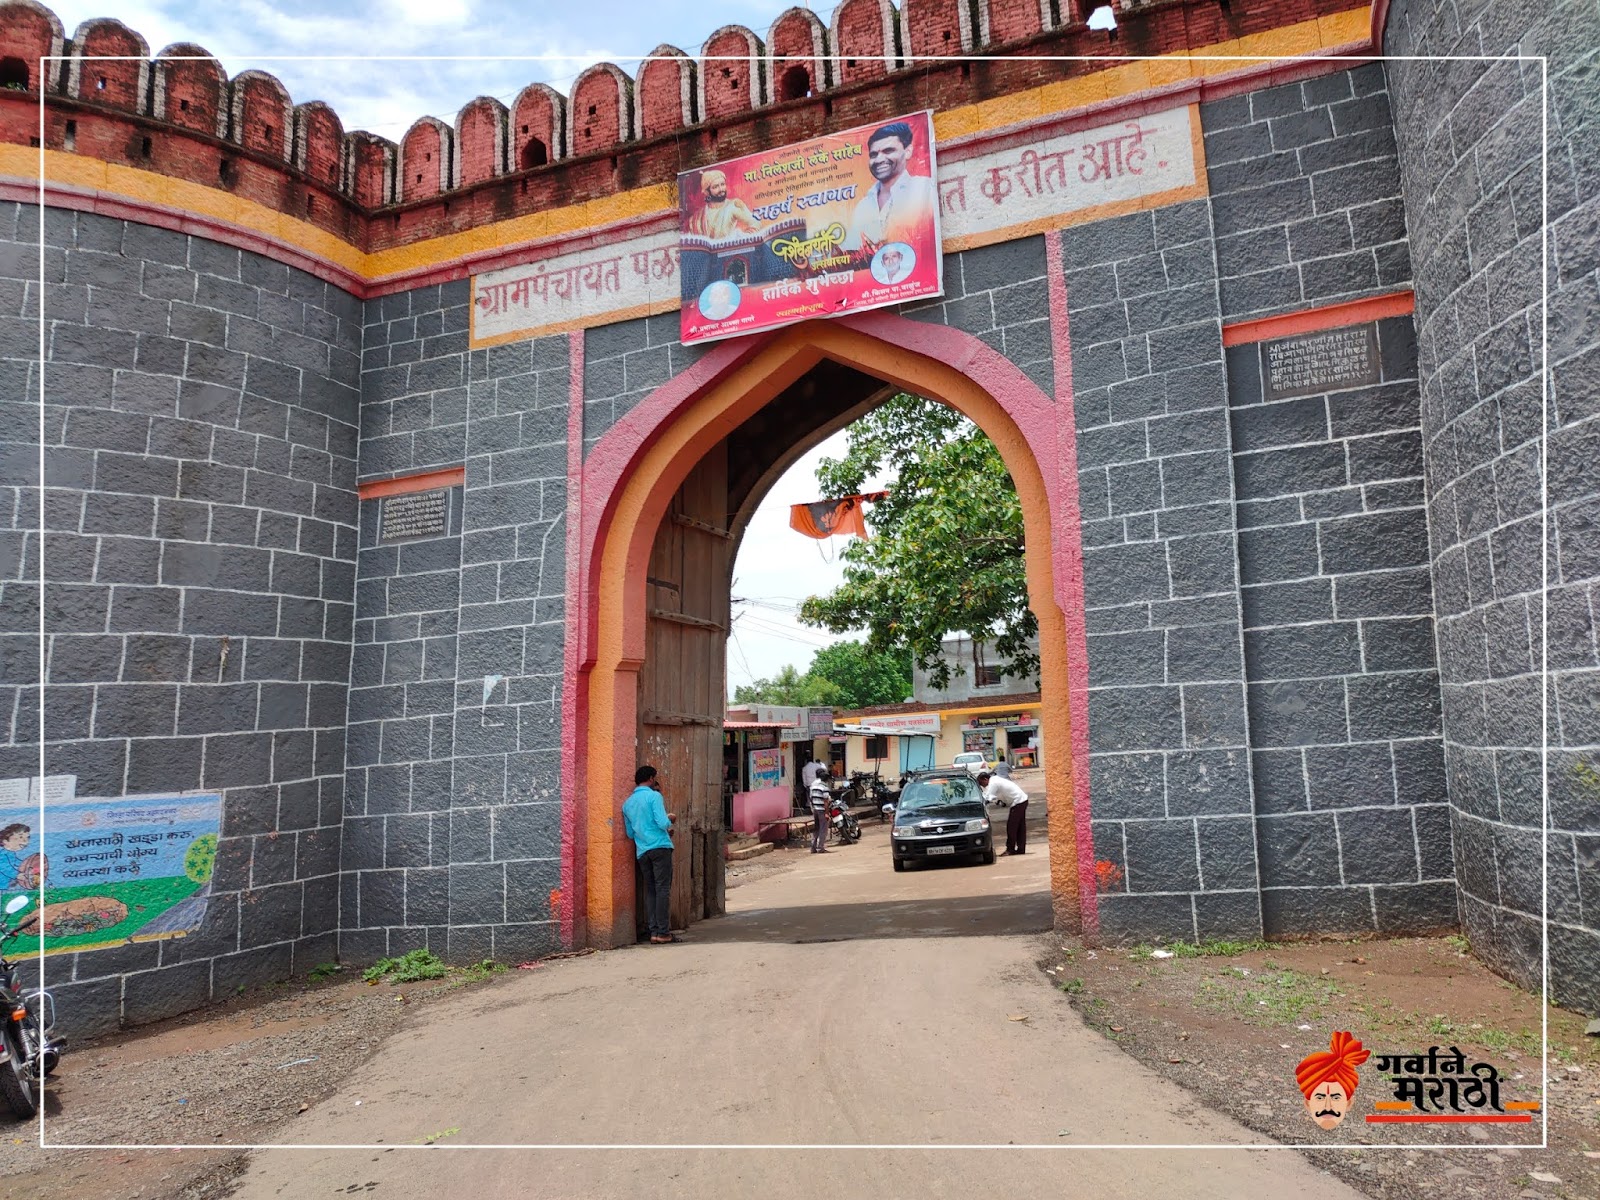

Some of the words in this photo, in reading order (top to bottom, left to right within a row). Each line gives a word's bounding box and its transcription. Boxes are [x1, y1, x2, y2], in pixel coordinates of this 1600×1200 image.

[808, 149, 830, 166] लंके
[832, 143, 863, 161] साहेब
[980, 149, 1074, 205] करीत
[752, 194, 794, 221] सहर्ष
[797, 183, 858, 210] स्वागत
[478, 264, 622, 318] ग्रामपंचायत
[762, 278, 802, 302] हार्दिक
[805, 270, 855, 295] शुभेच्छा
[127, 847, 159, 858] योग्य
[63, 867, 111, 878] व्यवस्था
